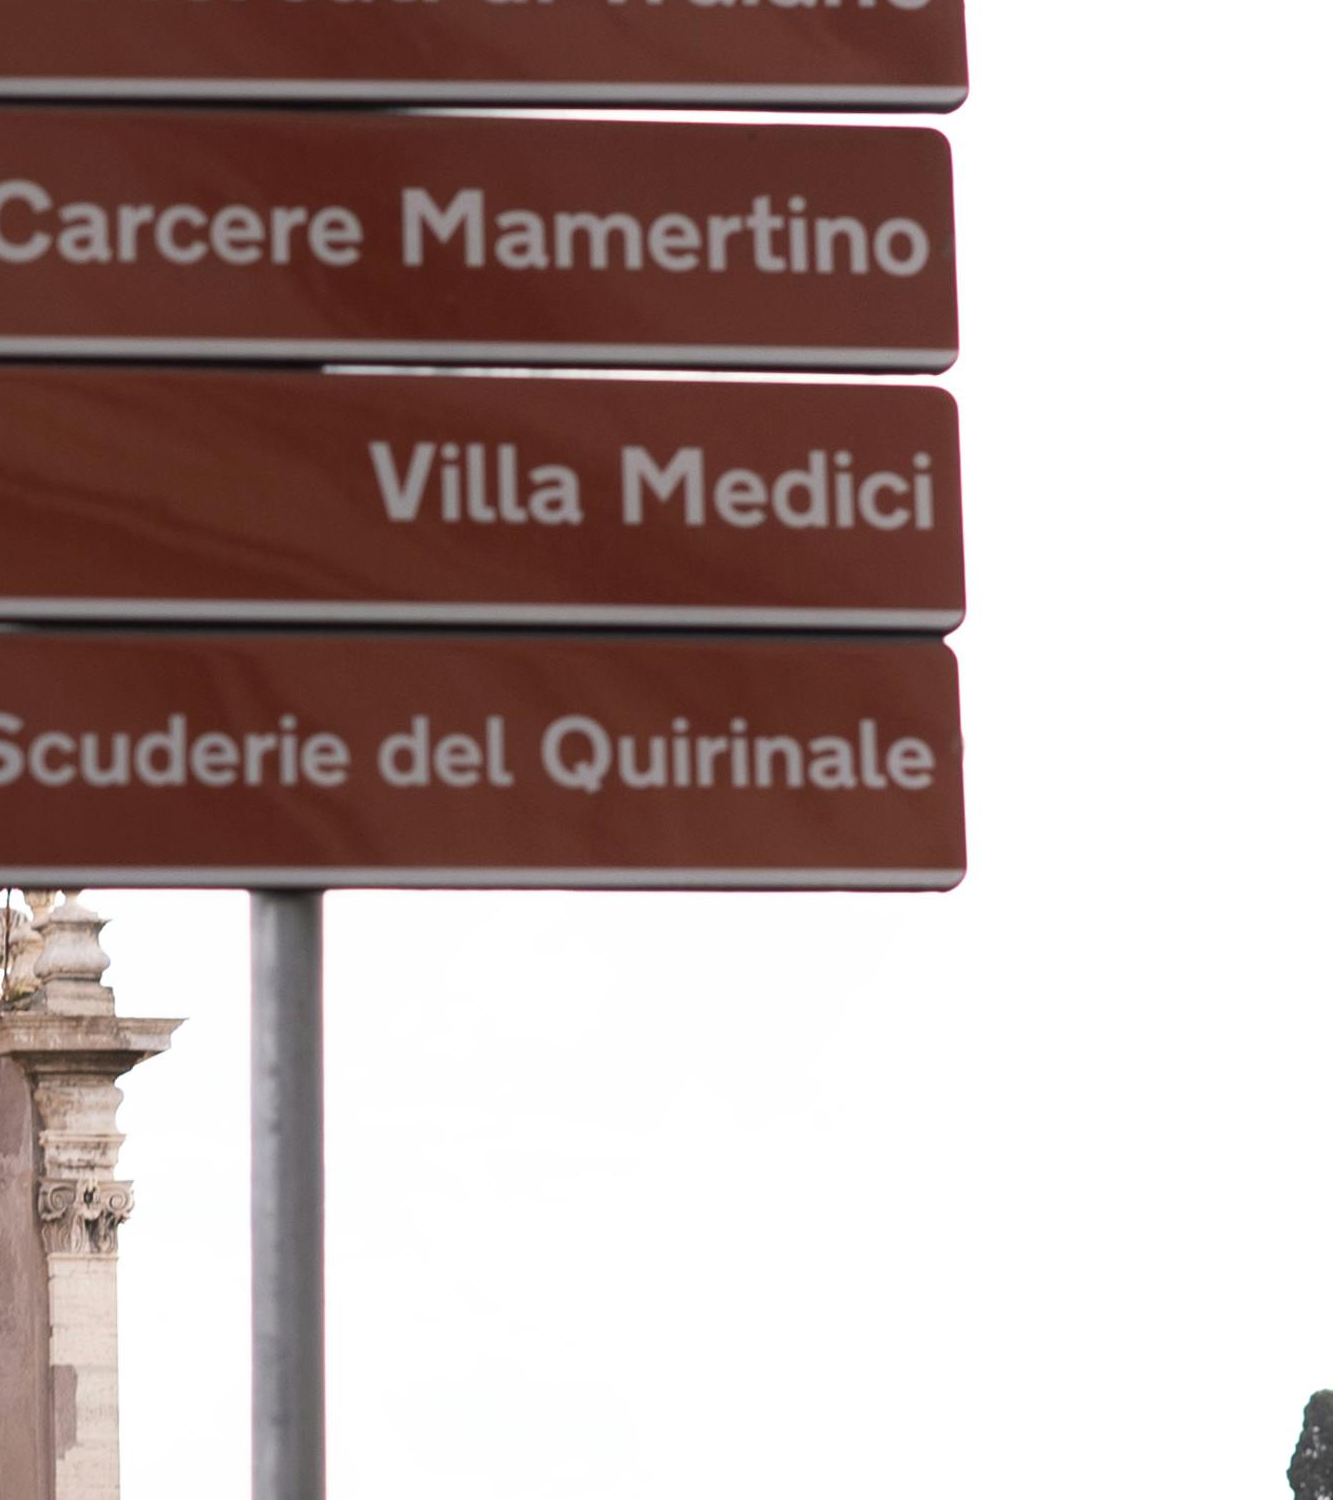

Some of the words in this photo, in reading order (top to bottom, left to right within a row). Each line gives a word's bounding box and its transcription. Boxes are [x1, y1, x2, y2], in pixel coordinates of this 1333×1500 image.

[401, 187, 931, 278] Mamertino
[369, 440, 584, 526] Villa
[621, 445, 935, 531] Medici
[377, 714, 515, 788] del
[540, 714, 936, 794] Quirinale
